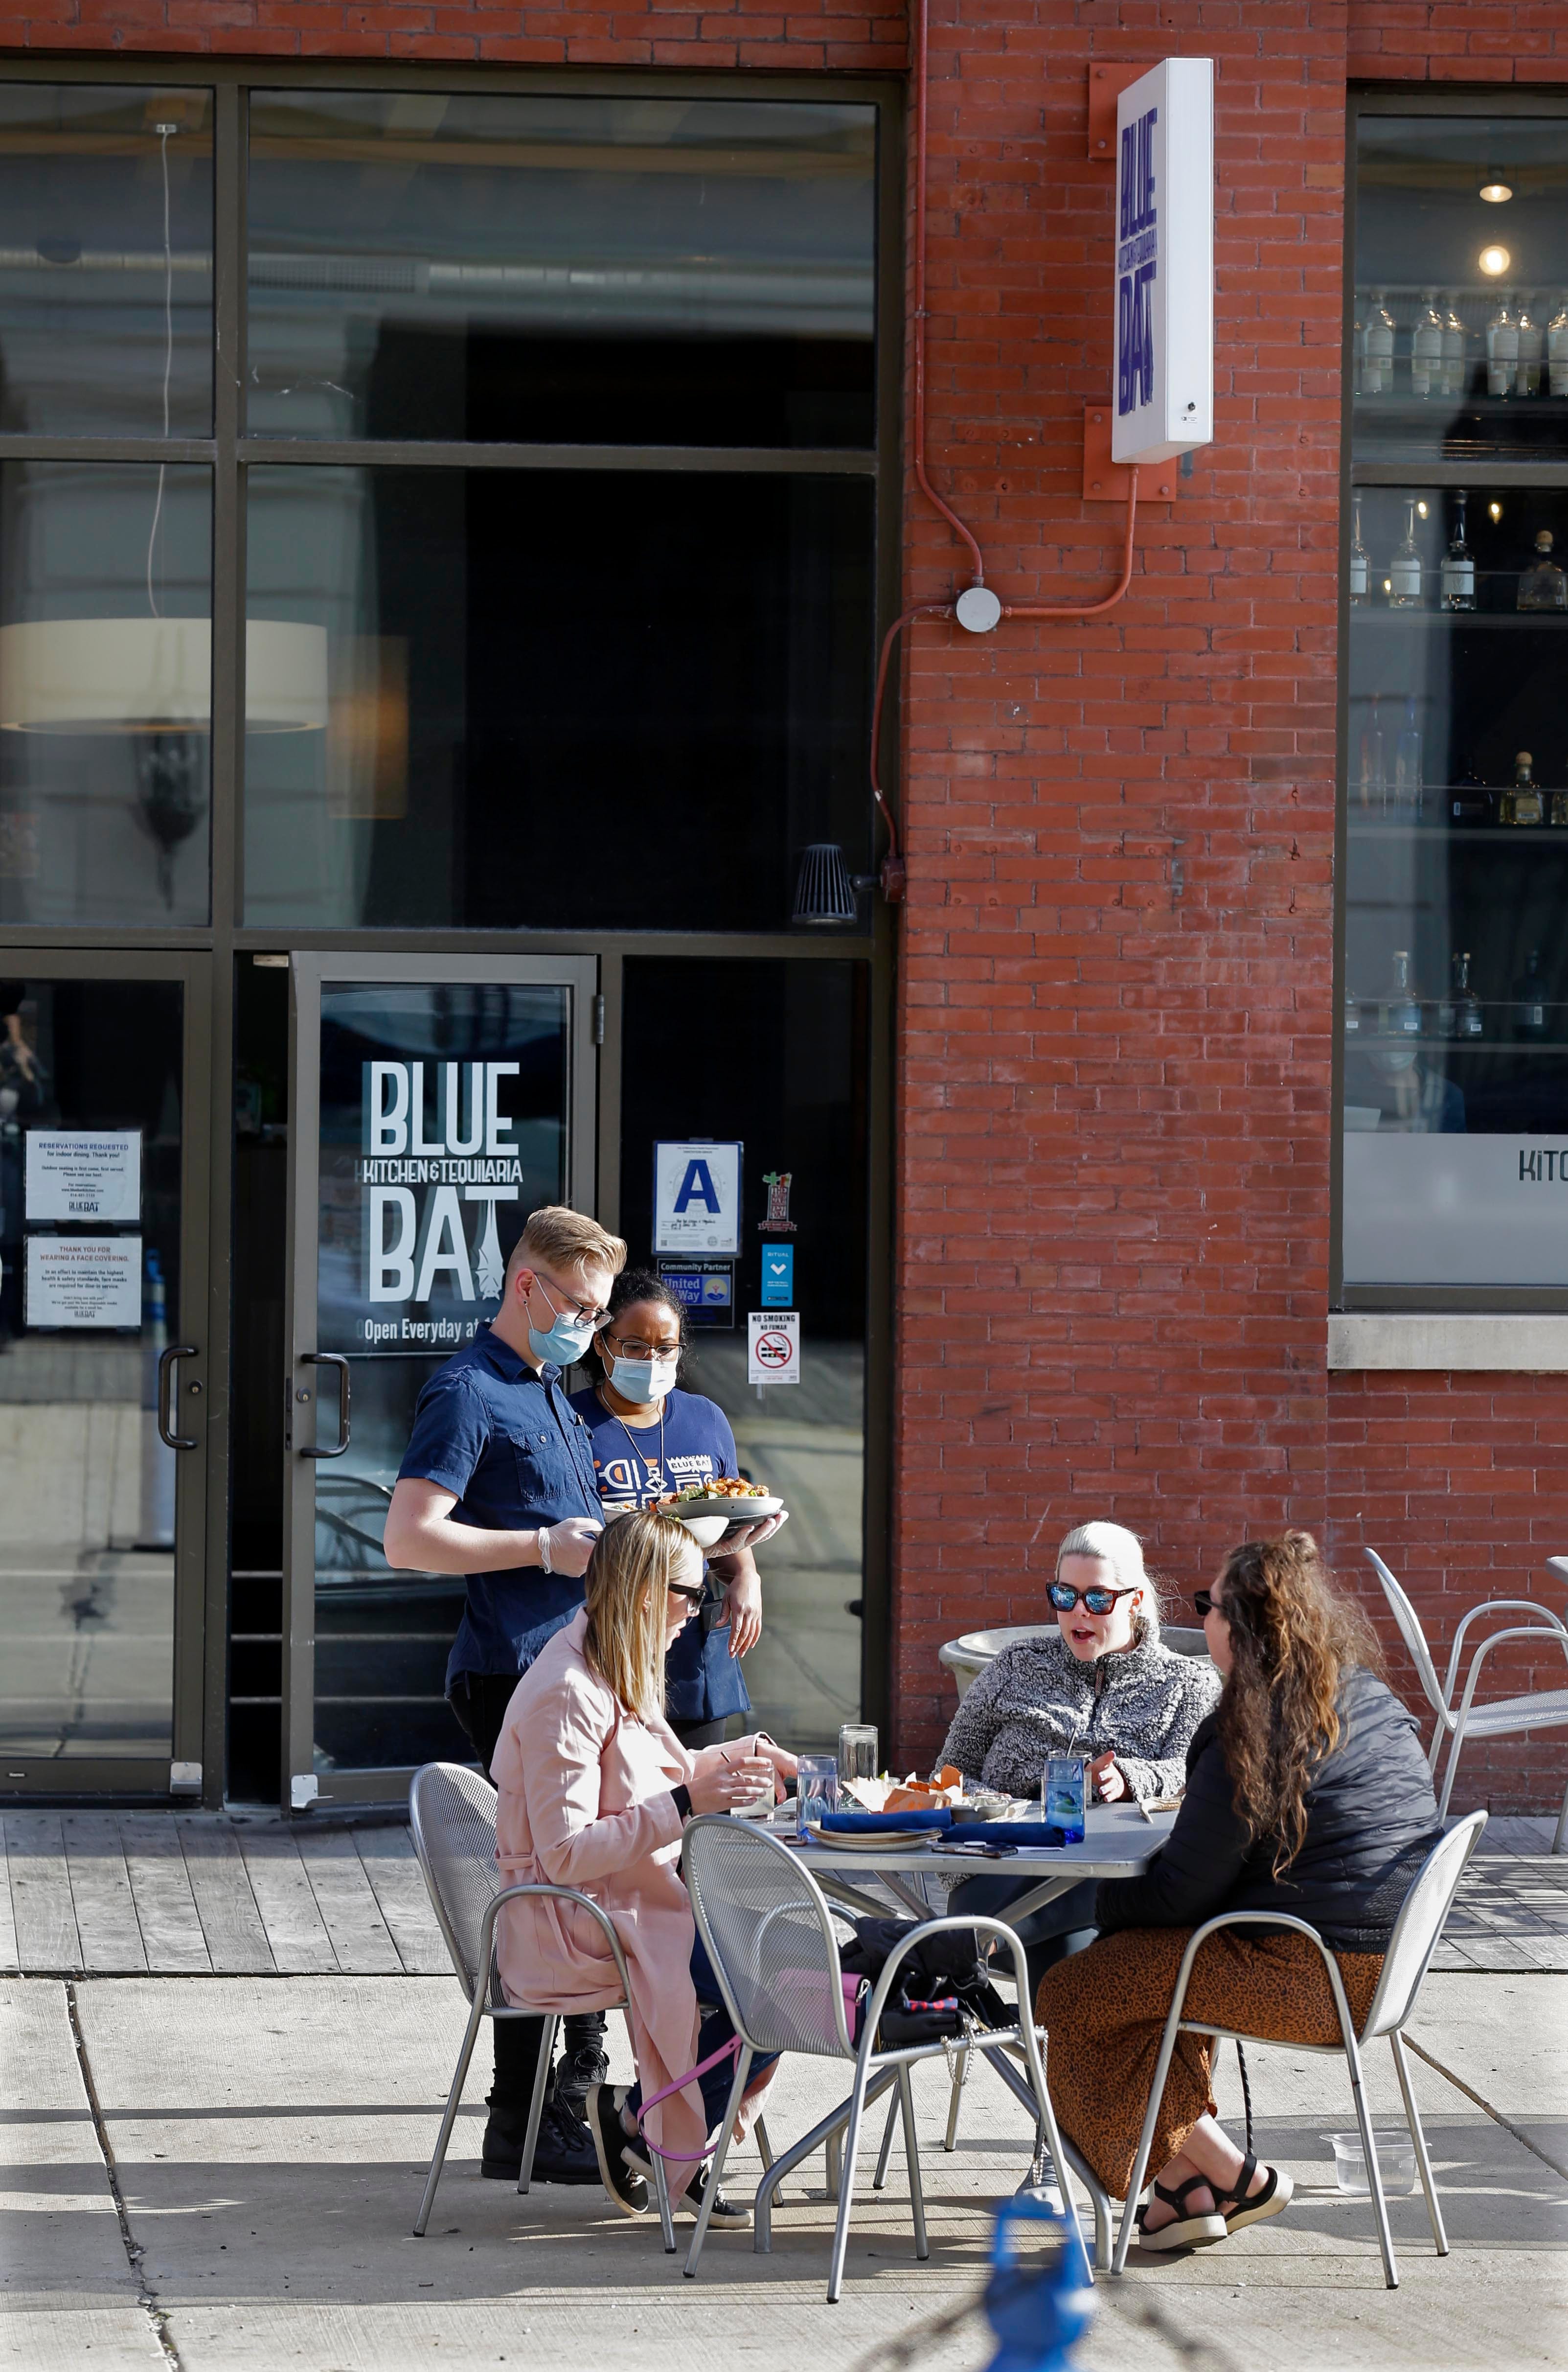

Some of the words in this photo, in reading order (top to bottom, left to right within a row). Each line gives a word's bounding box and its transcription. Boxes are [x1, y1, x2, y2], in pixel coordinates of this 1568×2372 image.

[1120, 107, 1158, 243] BLUE
[1118, 260, 1157, 417] BAT
[370, 1061, 520, 1156] BLUE
[673, 1159, 722, 1214] A
[369, 1185, 519, 1302] BAT
[660, 1263, 703, 1272] Community
[703, 1263, 731, 1271] Partner
[664, 1278, 701, 1289] United
[679, 1289, 700, 1303] Way
[364, 1318, 398, 1344] Open
[401, 1317, 462, 1343] Everyday
[671, 1460, 694, 1469] BLUE
